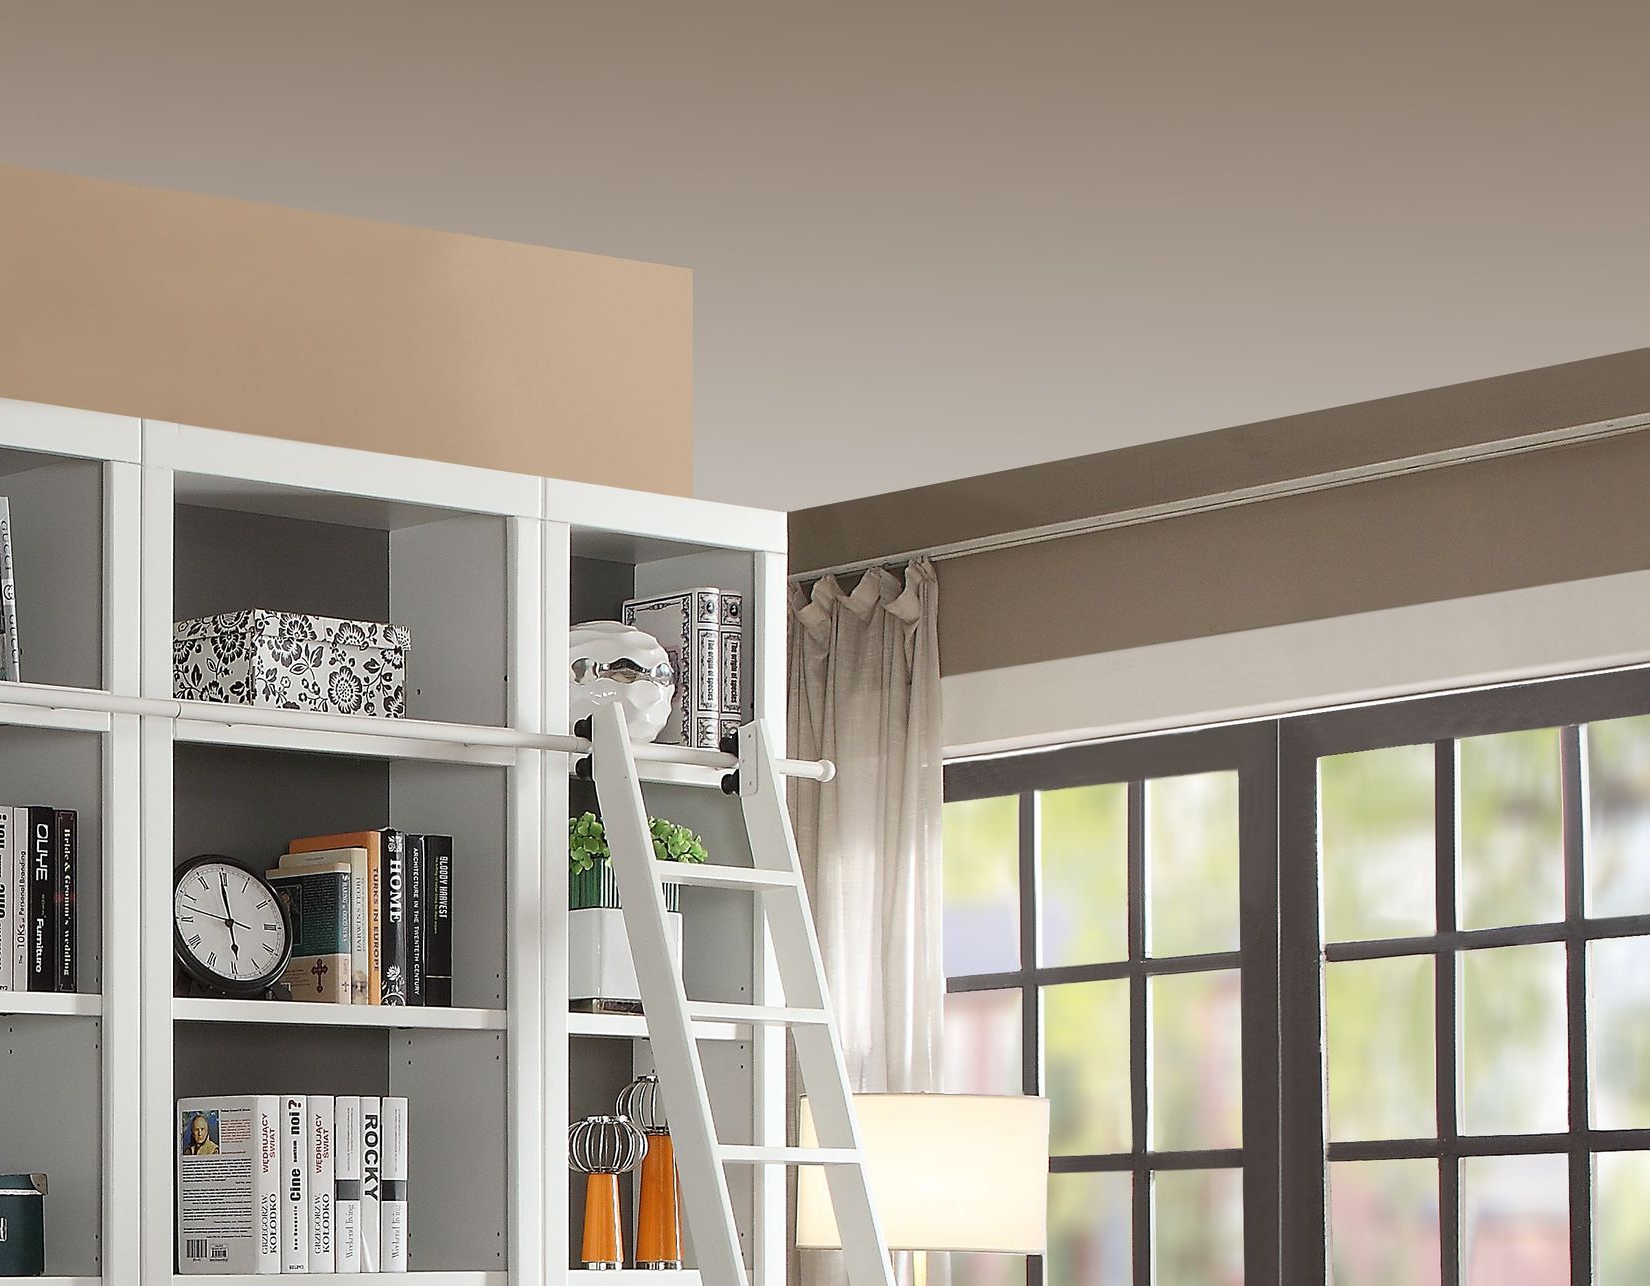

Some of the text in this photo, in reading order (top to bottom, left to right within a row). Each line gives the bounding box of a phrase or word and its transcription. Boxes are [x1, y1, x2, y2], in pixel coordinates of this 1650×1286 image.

[0, 520, 18, 665] GUCCI GUCCI
[373, 909, 379, 922] IN
[390, 858, 402, 924] HOME
[439, 856, 448, 918] BLOODY HARVEST
[288, 1100, 301, 1202] Cine noi?
[365, 1114, 378, 1201] ROCKY
